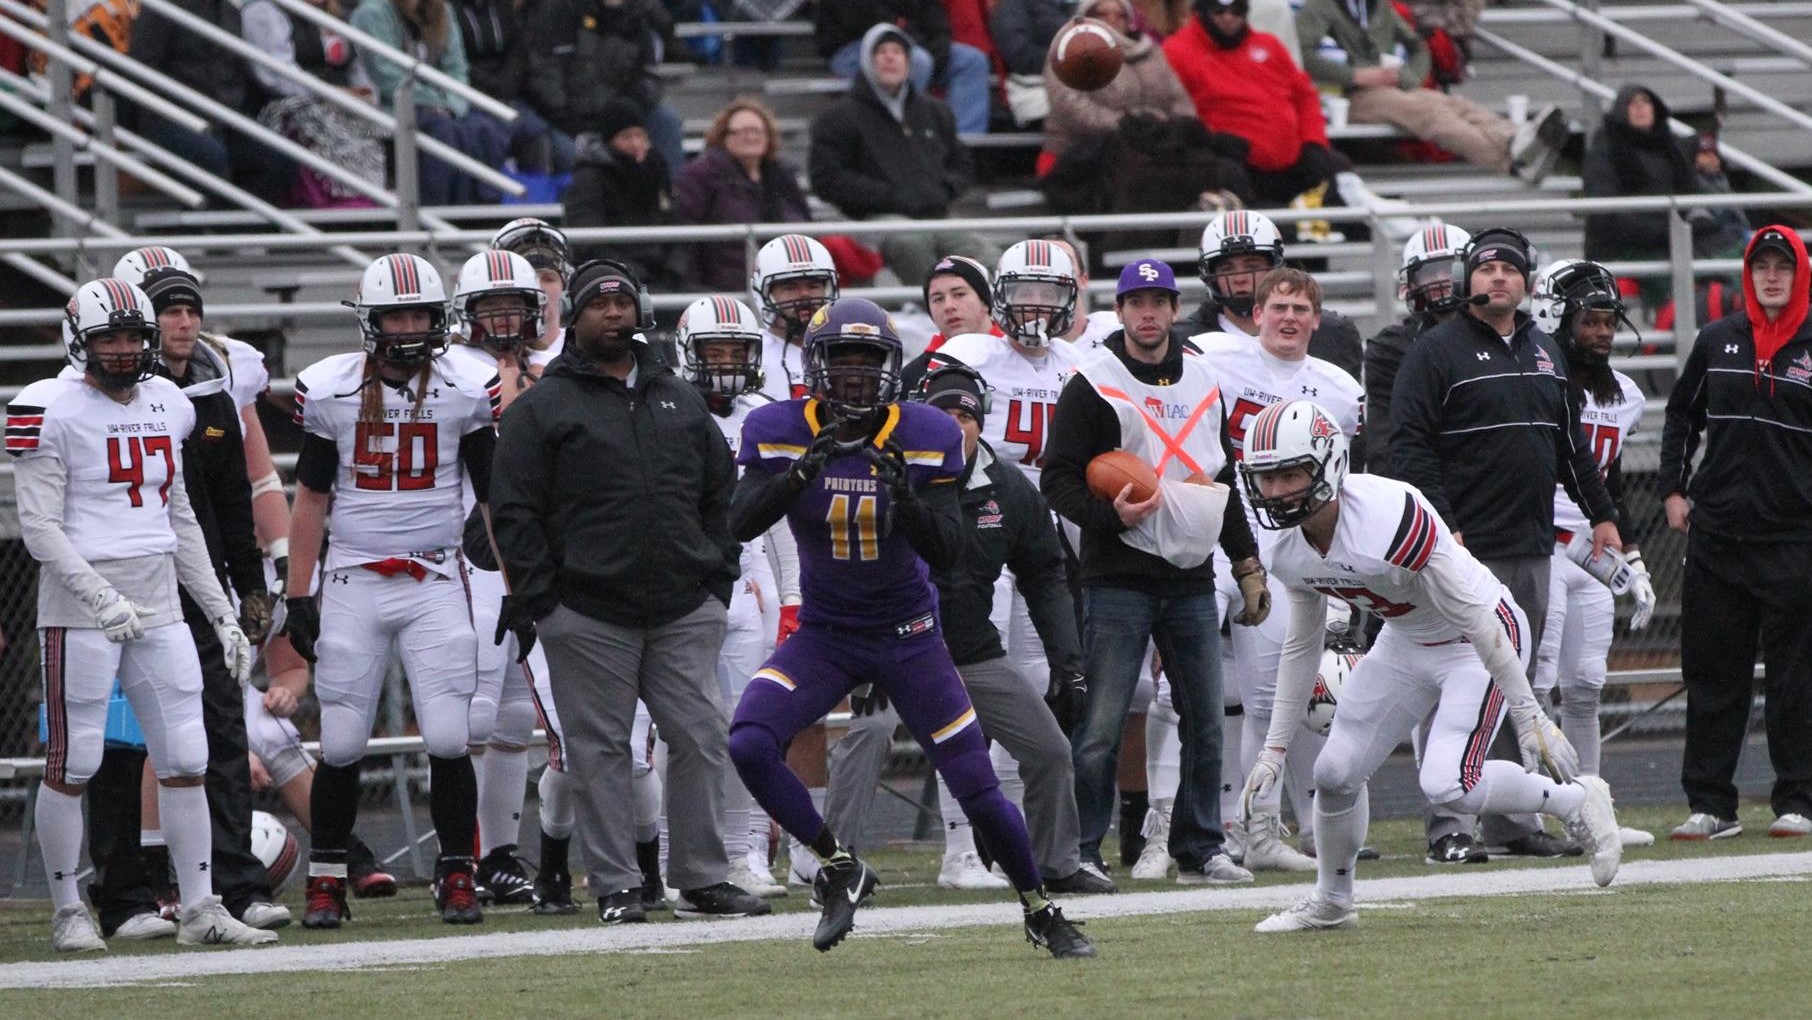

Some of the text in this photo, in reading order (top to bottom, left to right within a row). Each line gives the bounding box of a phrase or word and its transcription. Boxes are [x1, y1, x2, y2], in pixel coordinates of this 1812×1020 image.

[1139, 263, 1159, 281] SP
[107, 422, 167, 433] UW-RIVER FALLS
[353, 421, 438, 491] 50
[1004, 399, 1056, 468] 4
[106, 435, 175, 508] 47
[824, 477, 877, 492] POINTERS
[825, 494, 879, 561] 11
